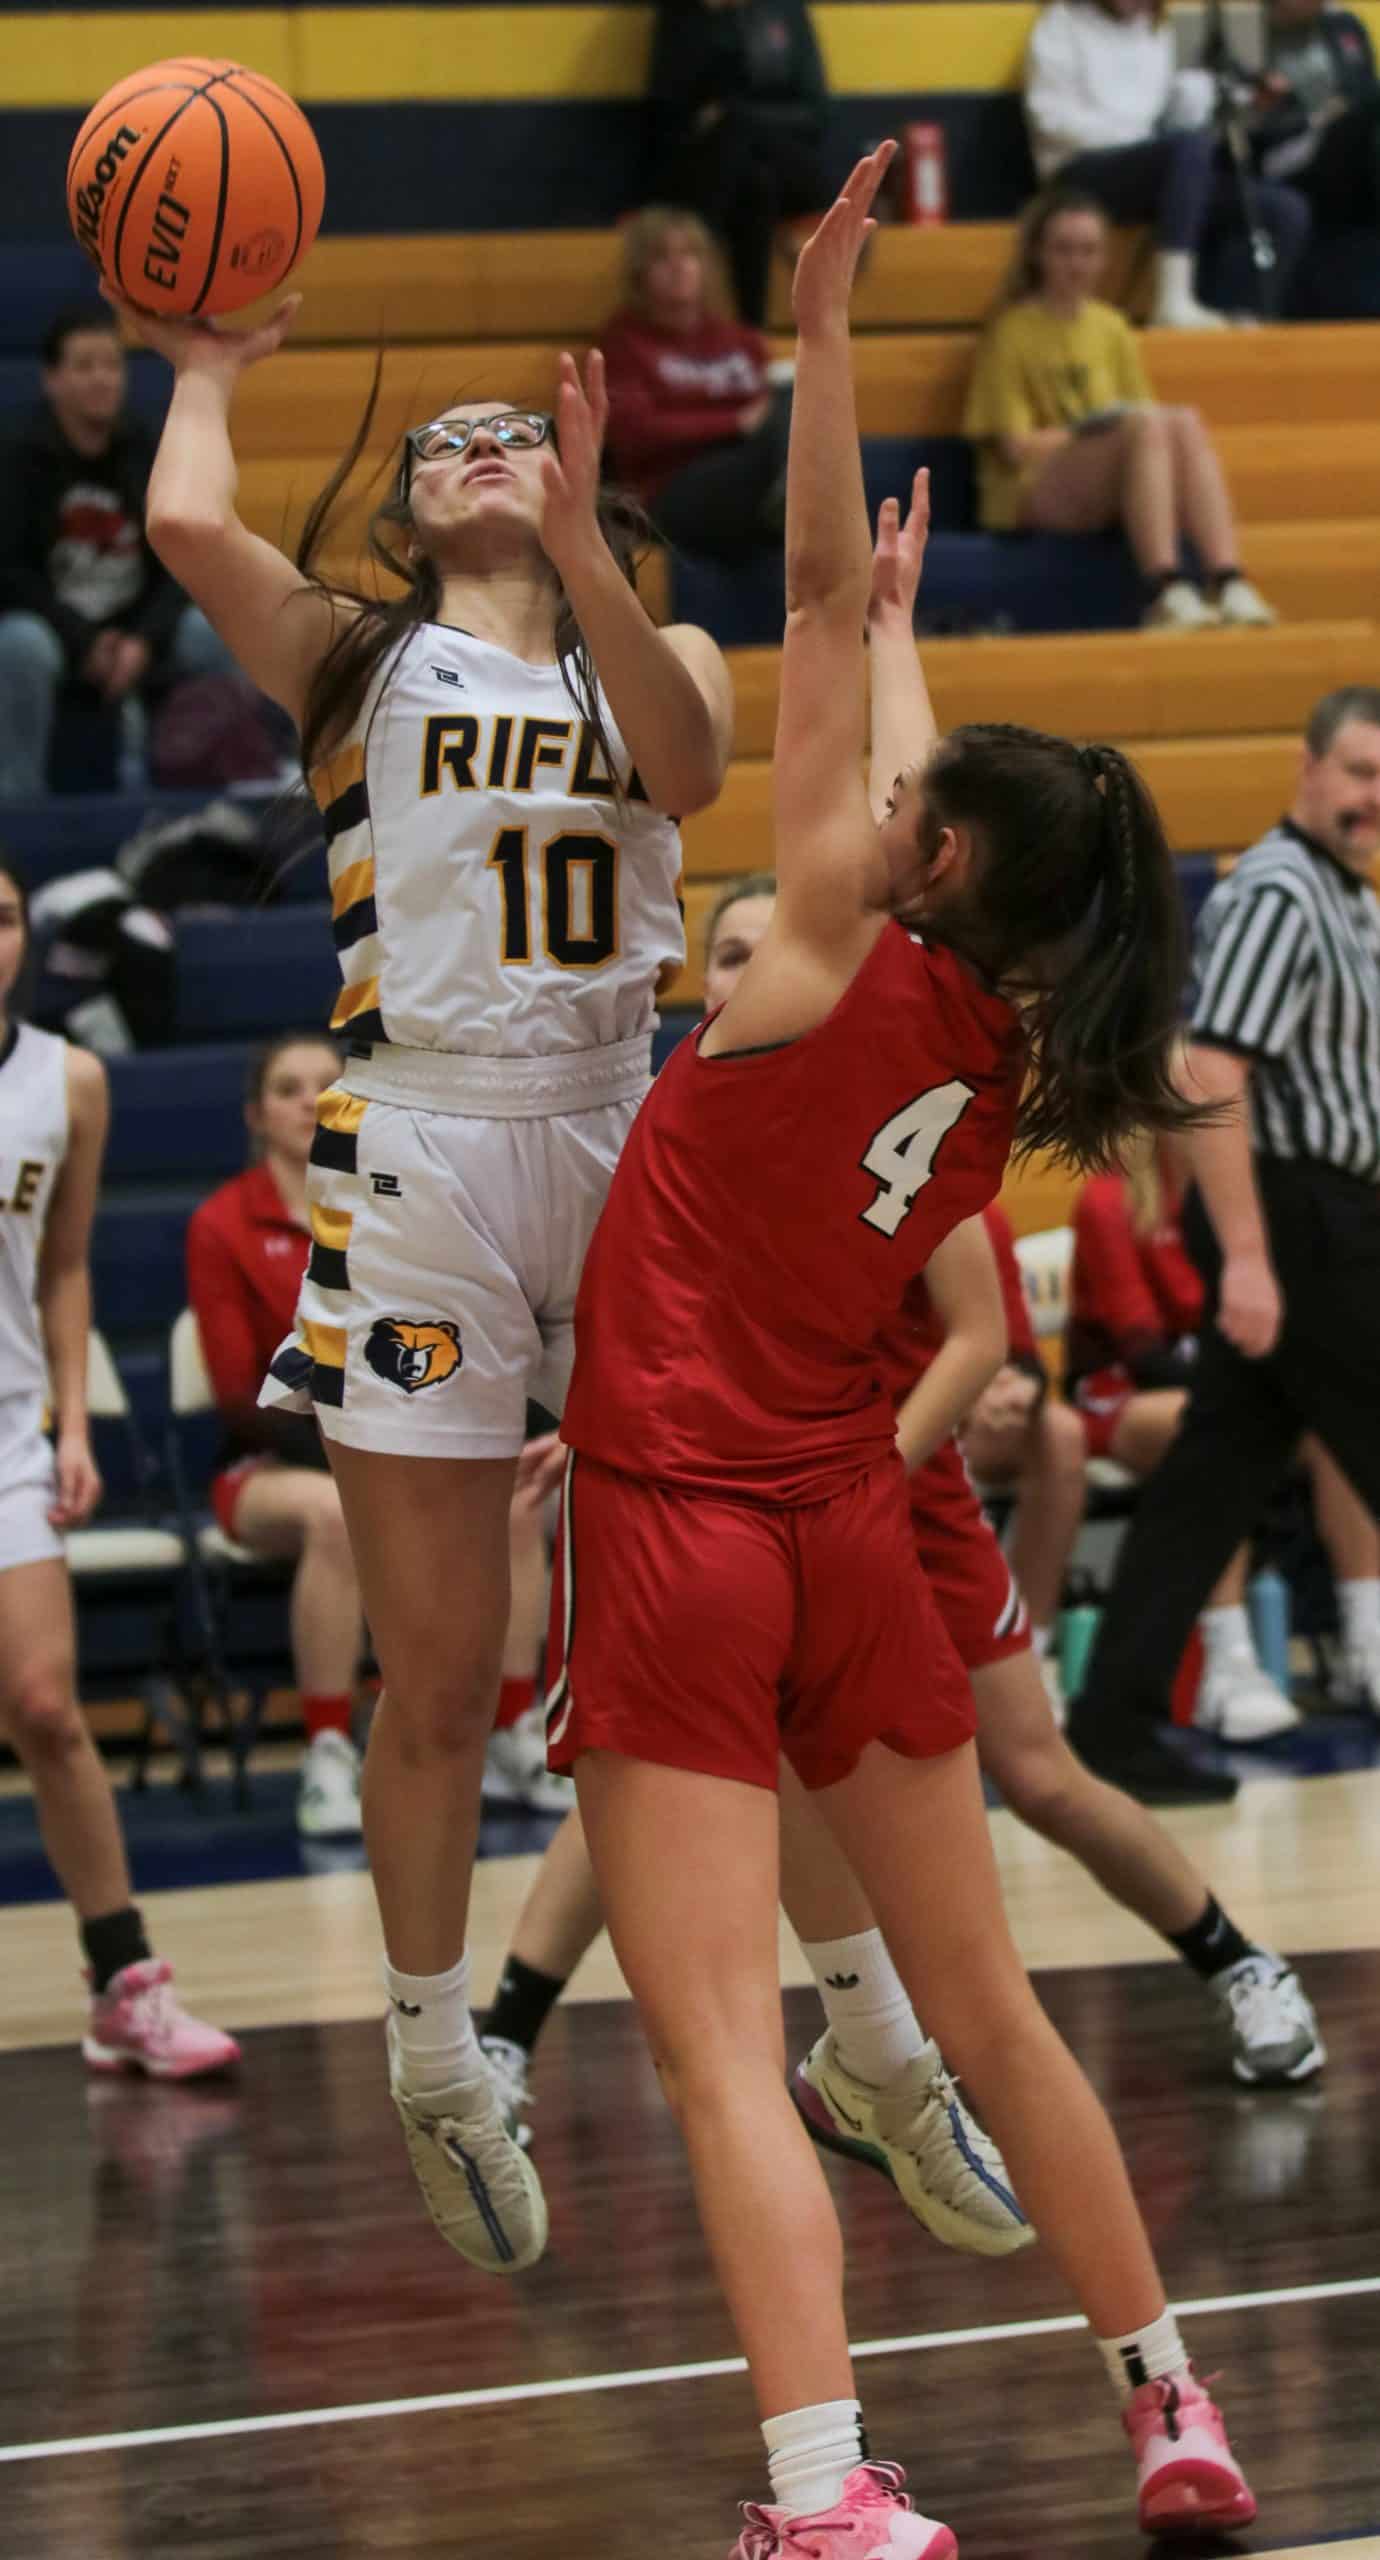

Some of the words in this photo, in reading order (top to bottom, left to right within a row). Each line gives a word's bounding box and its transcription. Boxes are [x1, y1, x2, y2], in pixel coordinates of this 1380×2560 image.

[143, 194, 191, 290] EVO
[419, 713, 652, 803] RIFL
[485, 825, 621, 970] 10
[0, 1160, 46, 1216] E
[858, 1076, 979, 1240] 4
